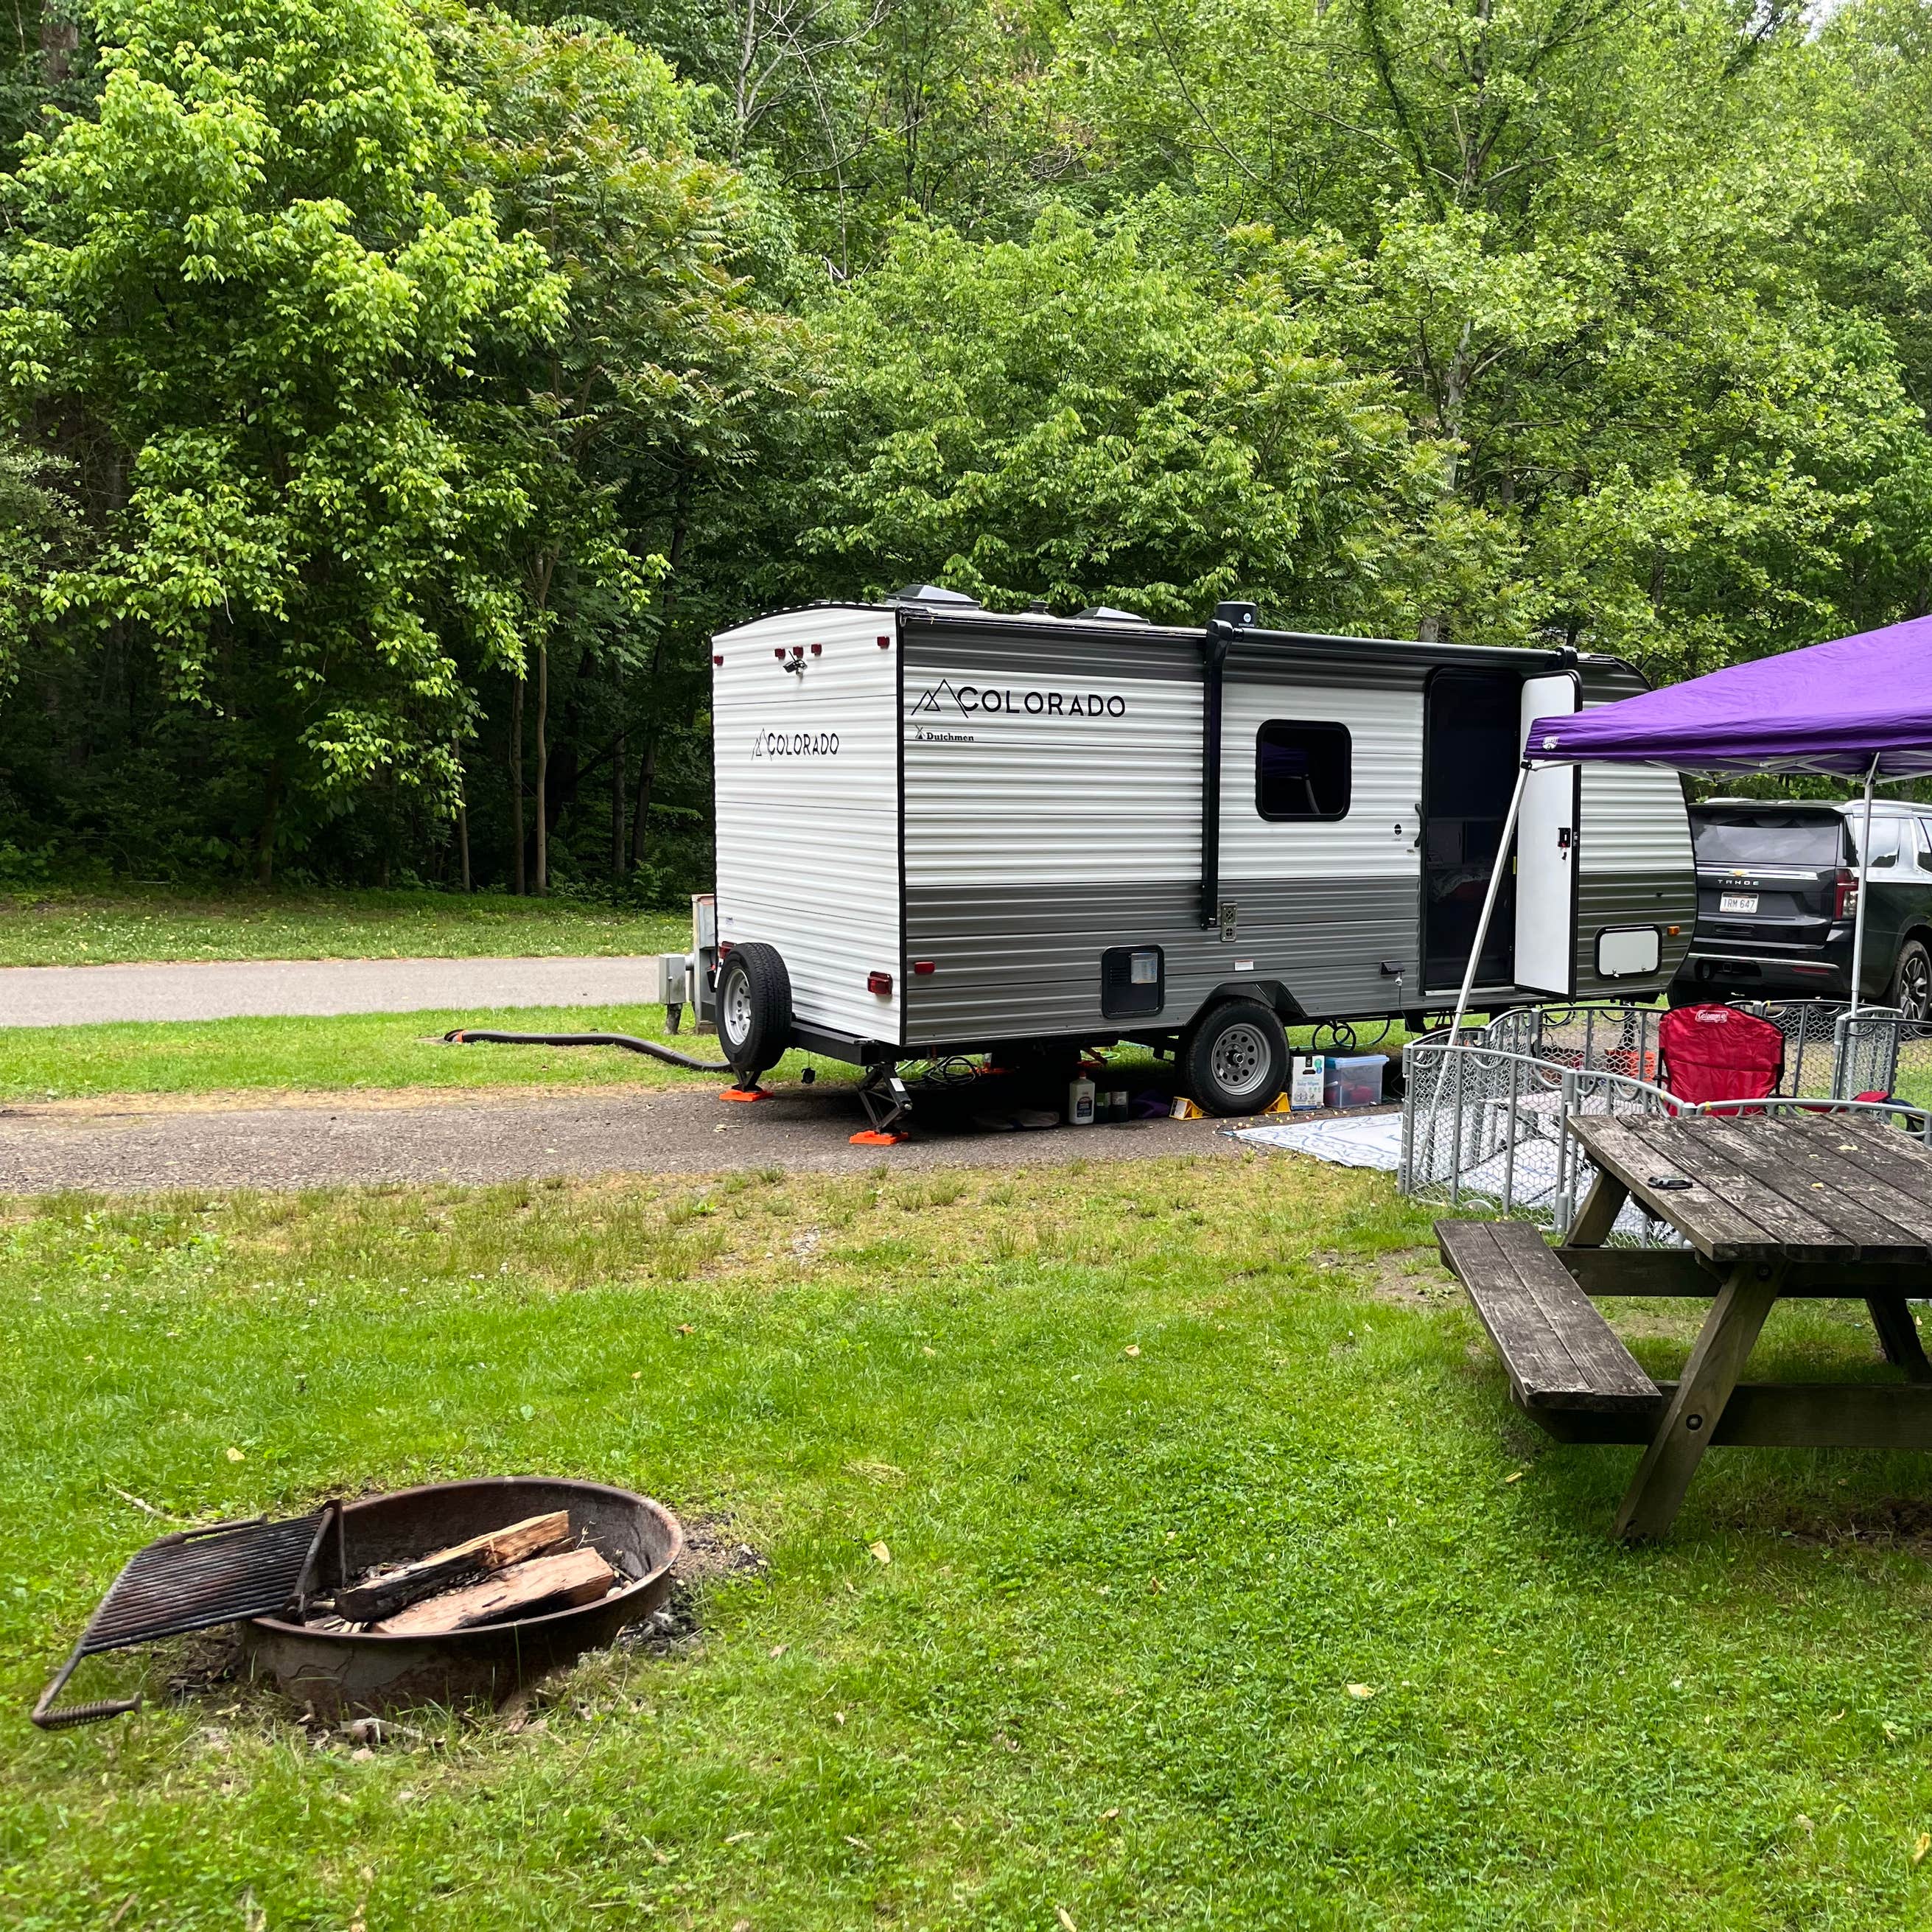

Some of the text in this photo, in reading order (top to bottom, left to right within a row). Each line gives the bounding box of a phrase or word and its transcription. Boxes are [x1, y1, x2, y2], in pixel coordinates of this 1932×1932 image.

[957, 686, 1126, 718] COLORADO
[767, 732, 839, 755] COLORADO
[926, 732, 974, 741] Dutchmen
[1740, 899, 1755, 909] 647
